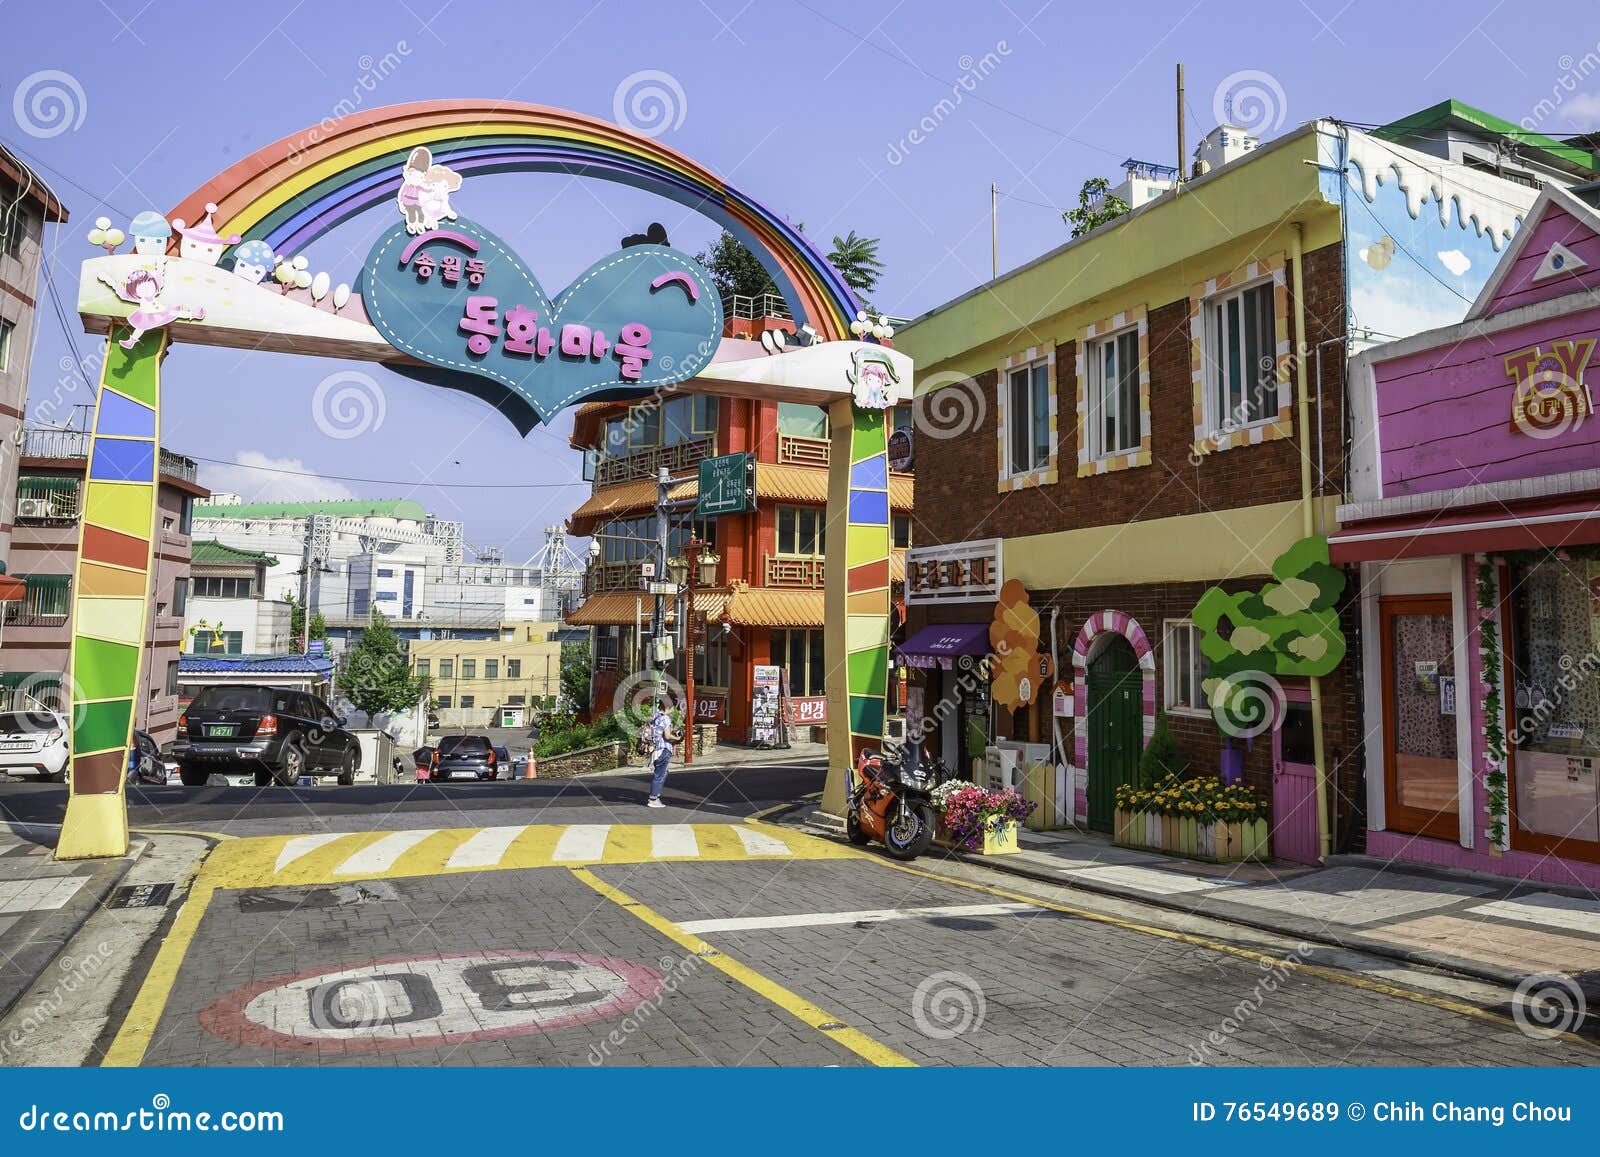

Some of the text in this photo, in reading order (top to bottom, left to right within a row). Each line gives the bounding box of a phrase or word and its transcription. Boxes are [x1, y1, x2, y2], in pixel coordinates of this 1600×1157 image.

[415, 251, 486, 285] 송월동
[459, 296, 653, 379] 동화마을
[1504, 339, 1596, 403] TOY
[698, 698, 718, 718] 오픈
[800, 701, 824, 720] 연경
[212, 727, 231, 736] 1471
